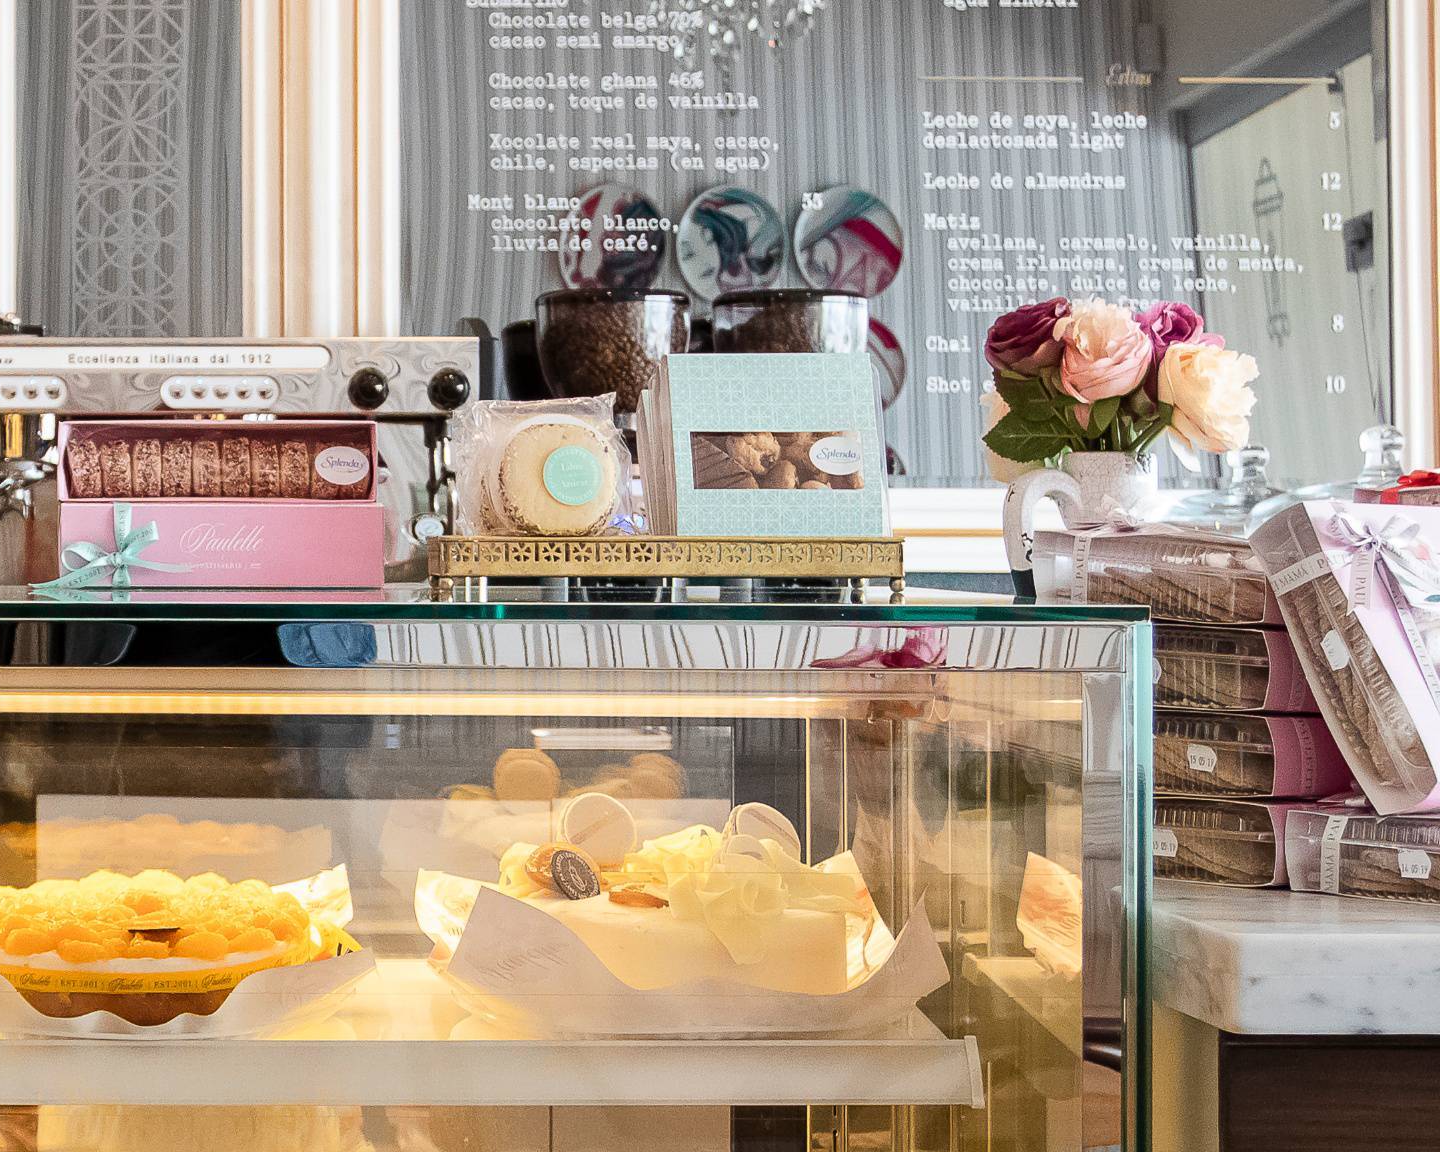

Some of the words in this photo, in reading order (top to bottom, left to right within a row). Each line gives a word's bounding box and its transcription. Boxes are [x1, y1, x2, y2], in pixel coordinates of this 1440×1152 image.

[489, 12, 590, 29] Chocolate
[601, 12, 656, 32] belga
[489, 36, 546, 49] cacao
[556, 33, 602, 49] semi
[612, 35, 681, 52] amargo
[489, 73, 590, 90] Chocolate
[601, 73, 657, 93] ghana
[668, 71, 704, 90] 46%
[489, 96, 555, 112] cacao,
[569, 94, 625, 113] toque
[634, 93, 658, 110] de
[668, 93, 759, 110] vainilla
[923, 112, 979, 129] Leche
[989, 112, 1013, 129] de
[1024, 115, 1077, 134] soya,
[1091, 112, 1147, 129] leche
[489, 133, 579, 151] Xocolate
[591, 133, 634, 150] real
[646, 136, 701, 153] maya,
[714, 136, 779, 152] cacao,
[923, 132, 1058, 150] deslactosada
[1070, 132, 1125, 153] light
[490, 154, 555, 172] chile,
[569, 154, 659, 173] especias
[670, 152, 704, 172] (en
[715, 152, 771, 173] agua)
[923, 173, 980, 190] Leche
[990, 173, 1013, 190] de
[1024, 173, 1126, 190] almendras
[1321, 172, 1341, 190] 12
[467, 194, 513, 211] Mont
[524, 194, 581, 211] blanc
[491, 215, 592, 232] chocolate
[603, 215, 679, 233] blanco,
[924, 214, 980, 231] Matiz
[1322, 213, 1342, 231] 12
[491, 235, 557, 252] lluvia
[569, 235, 592, 252] de
[603, 234, 658, 252] café.
[947, 234, 1046, 252] avellana,
[1059, 234, 1158, 252] caramelo,
[1171, 234, 1271, 252] vainilla,
[947, 257, 1004, 273] crema
[1016, 254, 1125, 273] irlandesa,
[1138, 257, 1194, 273] crema
[1205, 254, 1229, 271] de
[1239, 256, 1304, 273] menta,
[947, 275, 1058, 293] chocolate,
[1071, 275, 1127, 292] dulce
[1138, 275, 1162, 292] de
[1173, 275, 1237, 294] leche,
[925, 337, 971, 353] Chai
[67, 353, 140, 364] Eccellenza
[210, 353, 229, 364] dal
[241, 353, 272, 364] 1912
[926, 377, 971, 394] Shot
[1325, 376, 1345, 394] 10
[816, 447, 859, 463] Splenda
[321, 456, 366, 474] Splenda
